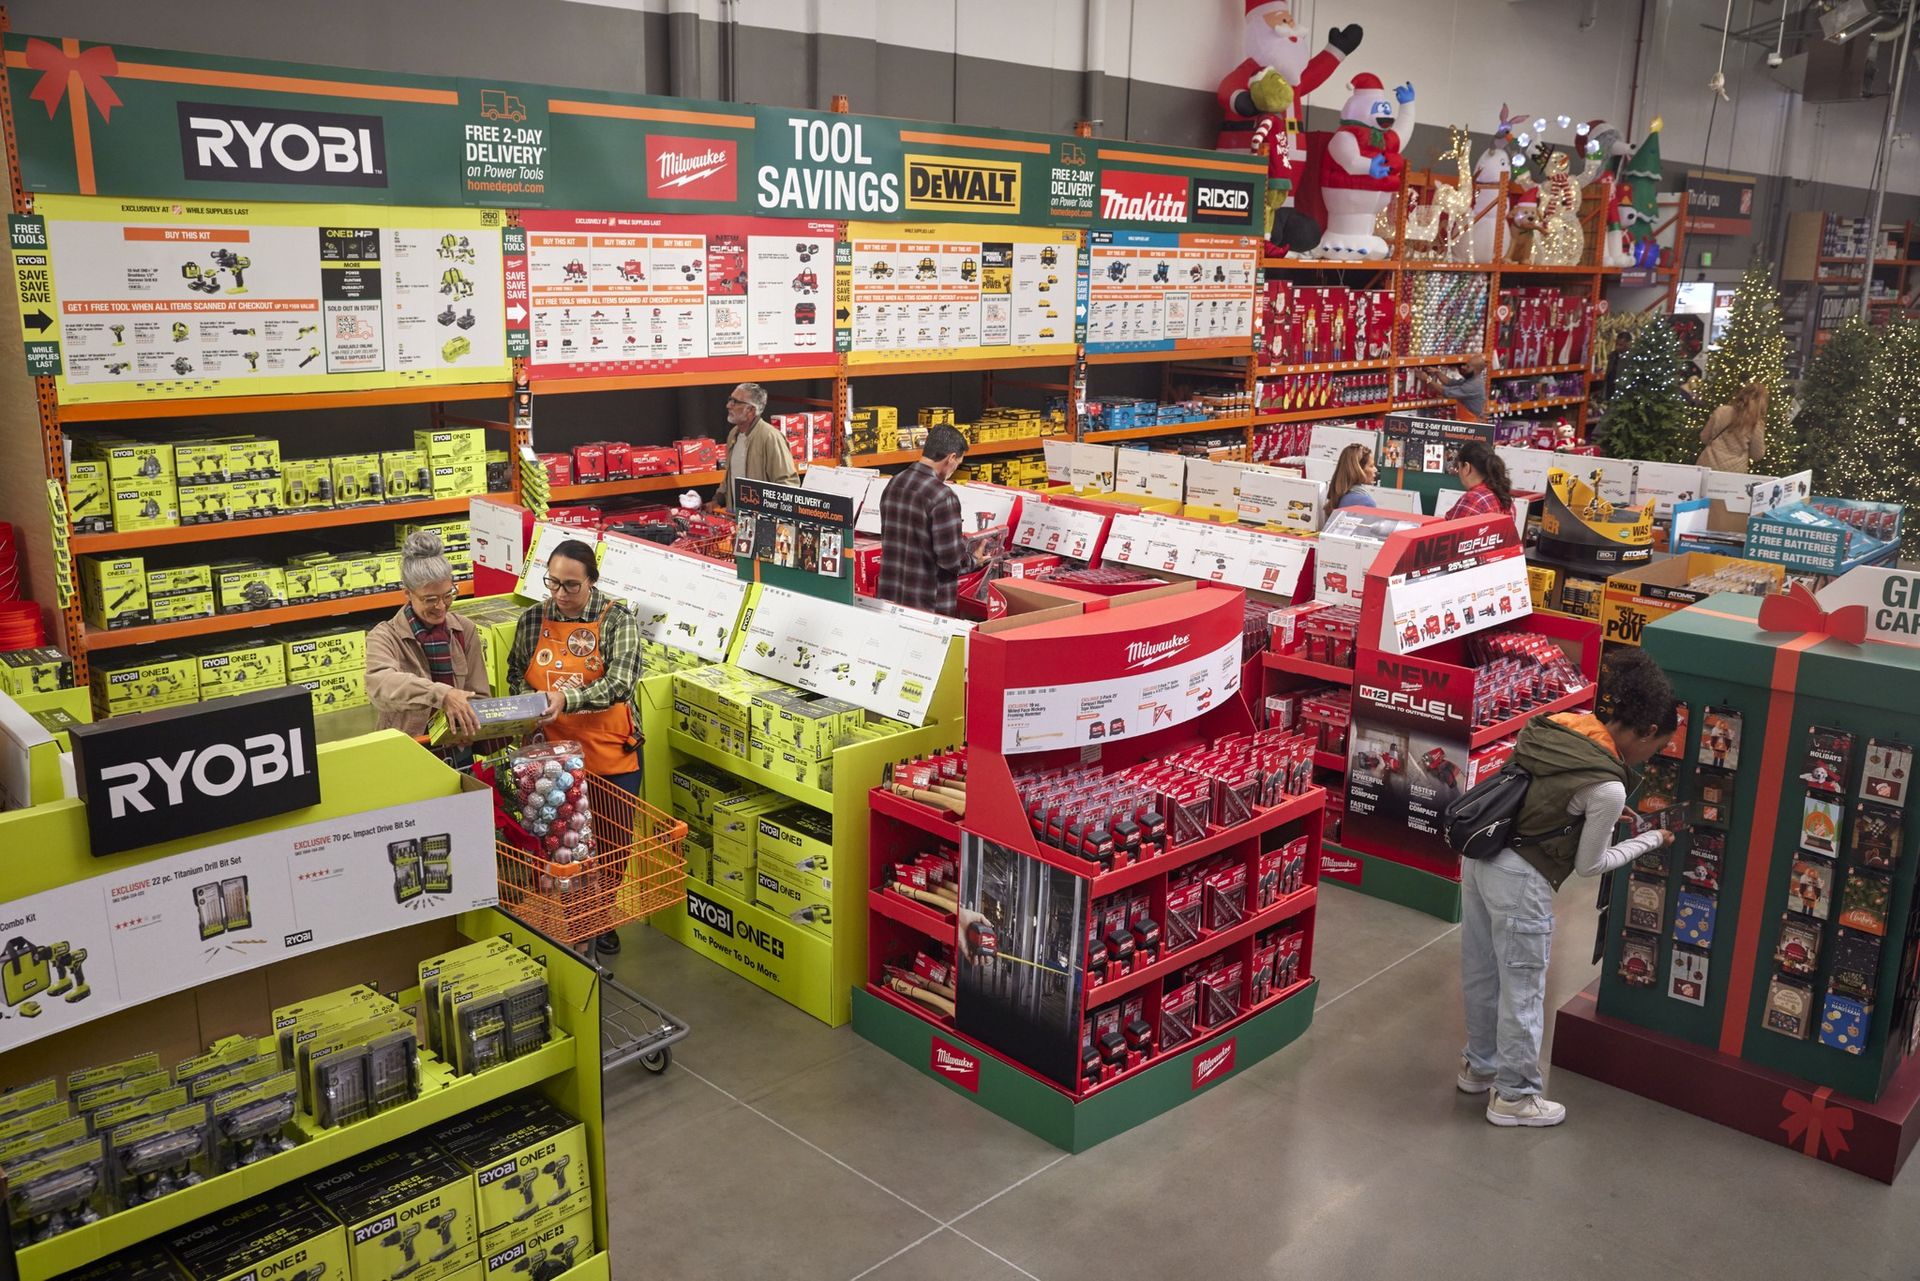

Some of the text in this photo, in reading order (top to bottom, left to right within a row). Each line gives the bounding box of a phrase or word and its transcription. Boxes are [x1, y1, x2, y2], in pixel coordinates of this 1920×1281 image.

[465, 125, 543, 145] FREE 2-DAY
[789, 118, 872, 164] TOOL
[189, 116, 374, 174] RYOBI
[655, 149, 727, 179] Milwaukee
[467, 164, 544, 181] on Power Tools
[1052, 168, 1094, 184] FREE 2-DAY
[467, 179, 544, 196] homedepot.com
[757, 165, 899, 213] SAVINGS
[1051, 196, 1093, 208] on Power Tools
[1198, 187, 1249, 209] RIDGID
[121, 205, 160, 213] EXCLUSIVELY
[186, 206, 204, 214] WHILE
[205, 207, 233, 215] SUPPLIES
[482, 212, 498, 220] 260
[14, 224, 41, 235] FREE
[165, 230, 210, 240] BUY THIS KIT
[12, 234, 46, 245] TOOLS
[505, 235, 523, 243] FREE
[504, 243, 525, 251] TOOLS
[837, 248, 850, 257] FREE
[17, 256, 46, 265] RYOBI
[18, 269, 48, 281] SAVE
[506, 272, 526, 280] SAVE
[20, 281, 50, 291] SAVE
[506, 281, 527, 290] SAVE
[836, 279, 850, 287] SAVE
[21, 292, 52, 303] SAVE
[507, 290, 528, 300] SAVE
[836, 287, 850, 295] SAVE
[67, 303, 82, 312] GET
[84, 303, 88, 311] 1
[90, 303, 109, 311] FREE
[111, 303, 130, 311] TOOL
[132, 303, 154, 311] WHEN
[155, 302, 169, 311] ALL
[171, 302, 193, 311] ITEMS
[193, 302, 227, 311] SCANNED
[228, 302, 237, 310] AT
[238, 301, 273, 310] CHECKOUT
[35, 360, 54, 368] LAST
[1411, 421, 1424, 430] FREE
[1425, 421, 1440, 431] 2-DAY
[1441, 423, 1467, 433] DELIVERY
[1633, 465, 1639, 476] 2
[762, 488, 777, 500] FREE
[777, 491, 793, 503] 2-DAY
[794, 494, 821, 508] DELIVERY
[763, 499, 844, 522] Power Tools homedepot.com
[1633, 525, 1649, 537] WAS
[1752, 522, 1838, 543] 2 FREE BATTERIES
[1472, 533, 1504, 550] FUEL
[1750, 535, 1837, 555] 2 FREE BATTERIES
[1749, 548, 1835, 568] 2 FREE BATTERIES
[1668, 591, 1696, 600] ATOMIC
[742, 609, 753, 631] RYOBI
[1619, 610, 1647, 625] SIZE
[1125, 634, 1190, 663] Milwaukee
[1377, 660, 1451, 690] NEW
[552, 677, 564, 688] THE
[1361, 687, 1464, 720] M12 FUEL
[1375, 701, 1396, 711] DRIVEN
[1809, 750, 1842, 763] HOLIDAYS
[101, 727, 305, 819] RYOBI
[1352, 773, 1384, 786] POWERFUL
[1350, 788, 1379, 801] COMPACT
[1410, 784, 1437, 797] FASTEST
[1350, 800, 1375, 812] FASTEST
[1408, 804, 1438, 818] COMPACT
[294, 835, 331, 851] EXCLUSIVE
[332, 833, 341, 842] 70
[342, 834, 352, 842] pc.
[353, 827, 376, 840] Impact
[377, 822, 393, 834] Drive
[394, 820, 404, 831] Bit
[404, 818, 416, 829] Set
[759, 823, 780, 838] RYOBI
[1407, 821, 1438, 835] VISIBILITY
[1321, 856, 1357, 868] Milwaukee
[1690, 850, 1719, 862] HOLIDAYS
[111, 879, 151, 897] EXCLUSIVE
[152, 876, 161, 887] 22
[161, 876, 173, 886] pc.
[174, 866, 204, 880] Titanium
[204, 861, 218, 873] Drill
[220, 859, 230, 870] Bit
[231, 856, 242, 867] Set
[758, 874, 779, 892] RYOBI
[688, 895, 732, 933] RYOBI
[0, 913, 37, 932] Combo Kit
[286, 933, 312, 946] RYOBI
[693, 927, 781, 983] The Power To Do More.
[422, 968, 440, 979] RYOBI
[455, 993, 473, 1003] RYOBI
[277, 1018, 297, 1028] RYOBI
[297, 1031, 317, 1043] RYOBI
[937, 1048, 974, 1069] Milwaukee
[1197, 1045, 1232, 1073] Milwaukee
[479, 1162, 517, 1184] RYOBI
[355, 1216, 397, 1242] RYOBI
[489, 1245, 525, 1269] RYOBI
